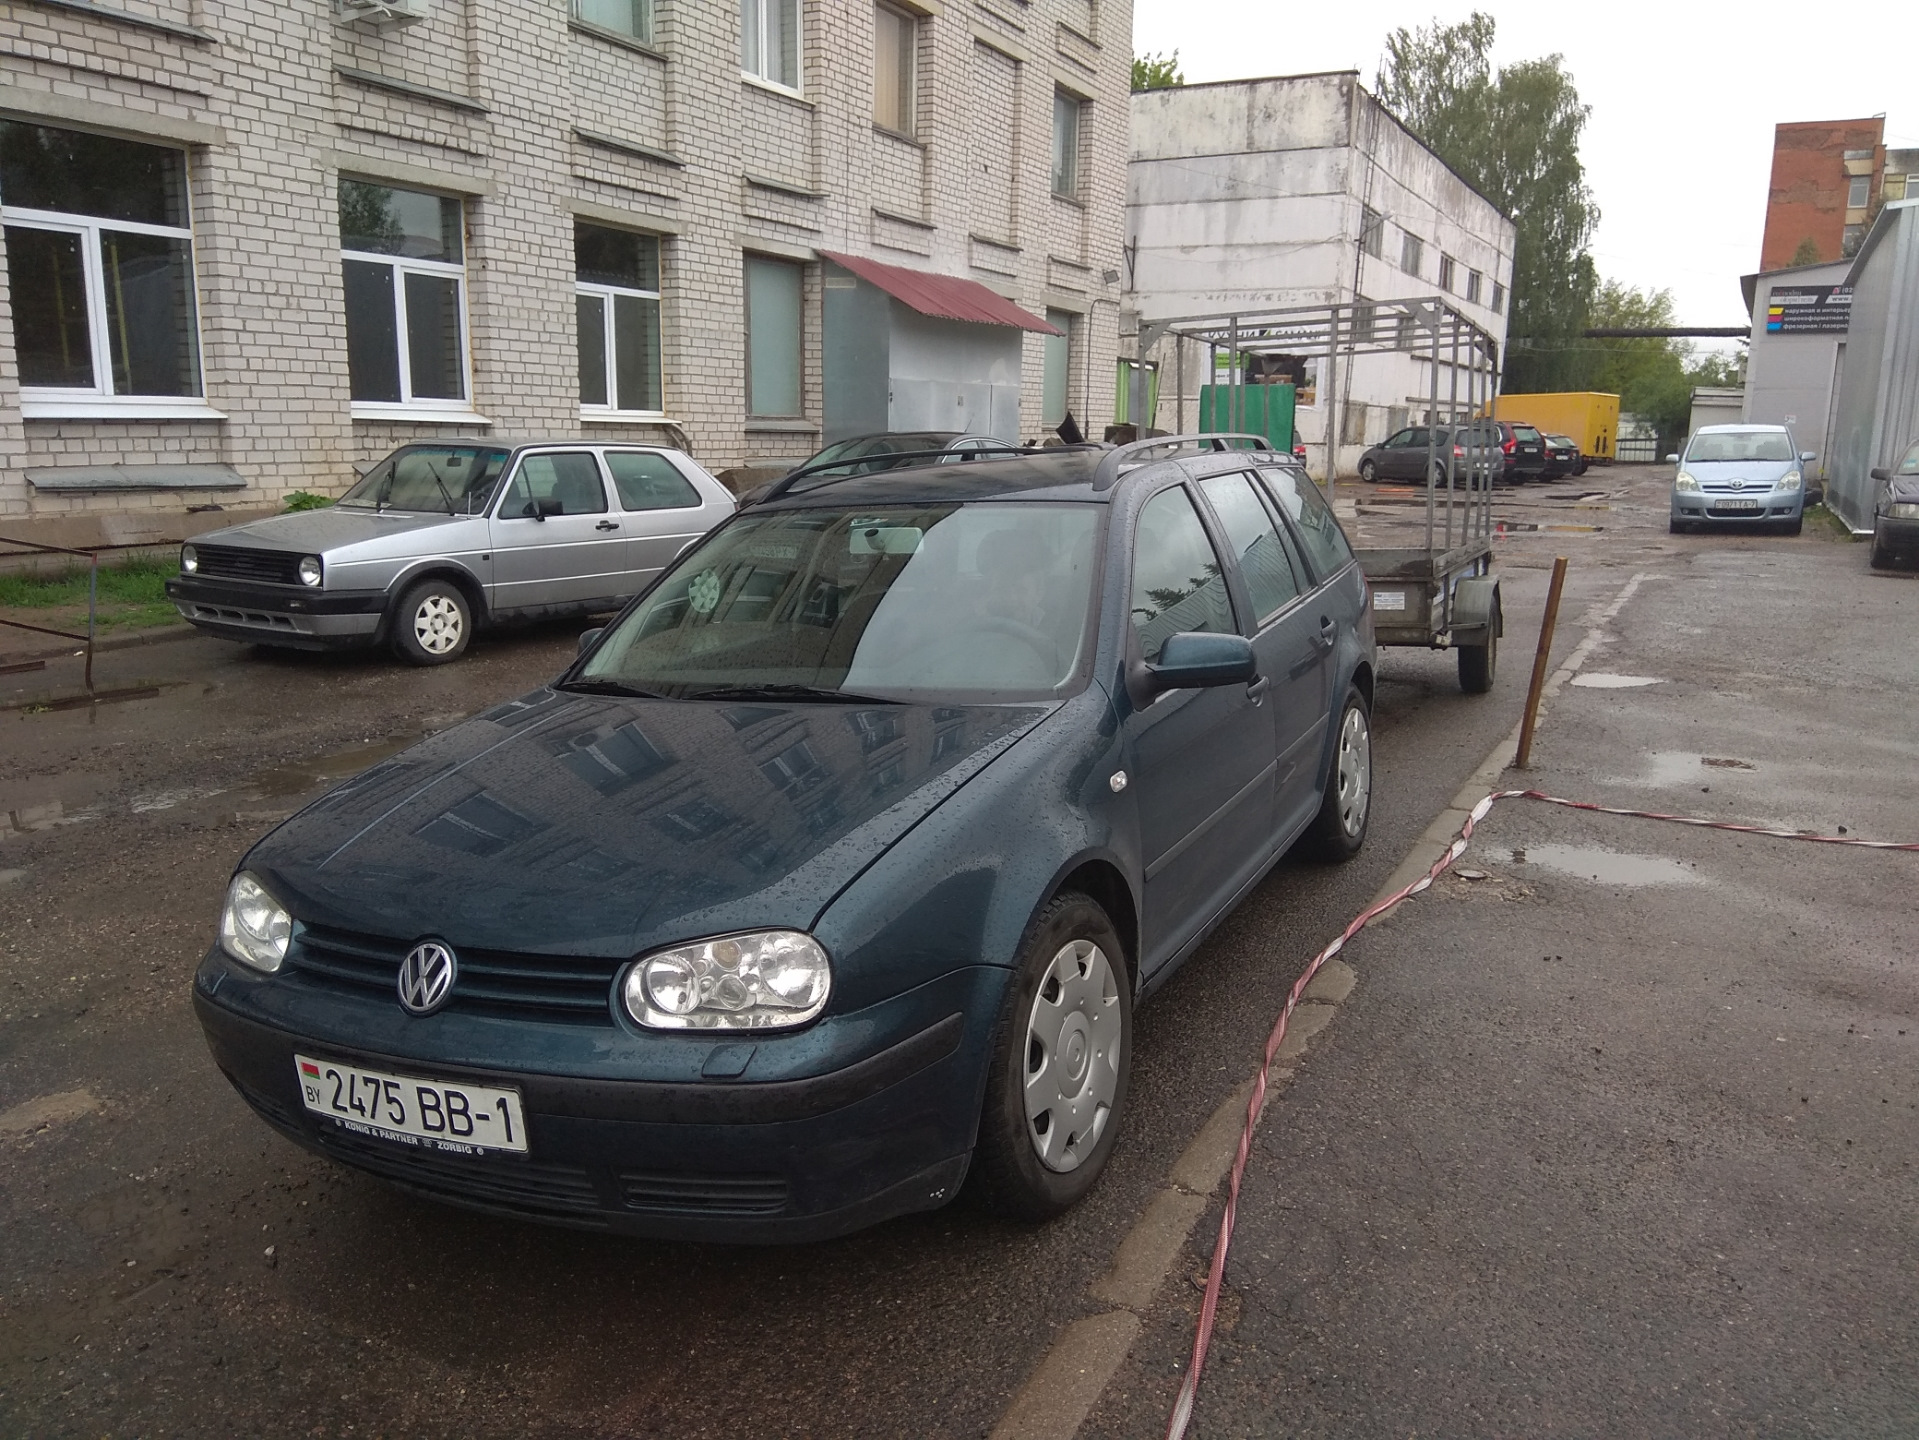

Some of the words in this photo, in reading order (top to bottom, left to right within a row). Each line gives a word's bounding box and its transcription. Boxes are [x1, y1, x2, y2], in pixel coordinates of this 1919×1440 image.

[305, 1085, 321, 1104] BY
[325, 1068, 406, 1126] 2475
[416, 1086, 514, 1144] BB-1
[379, 1131, 418, 1146] PARTNER
